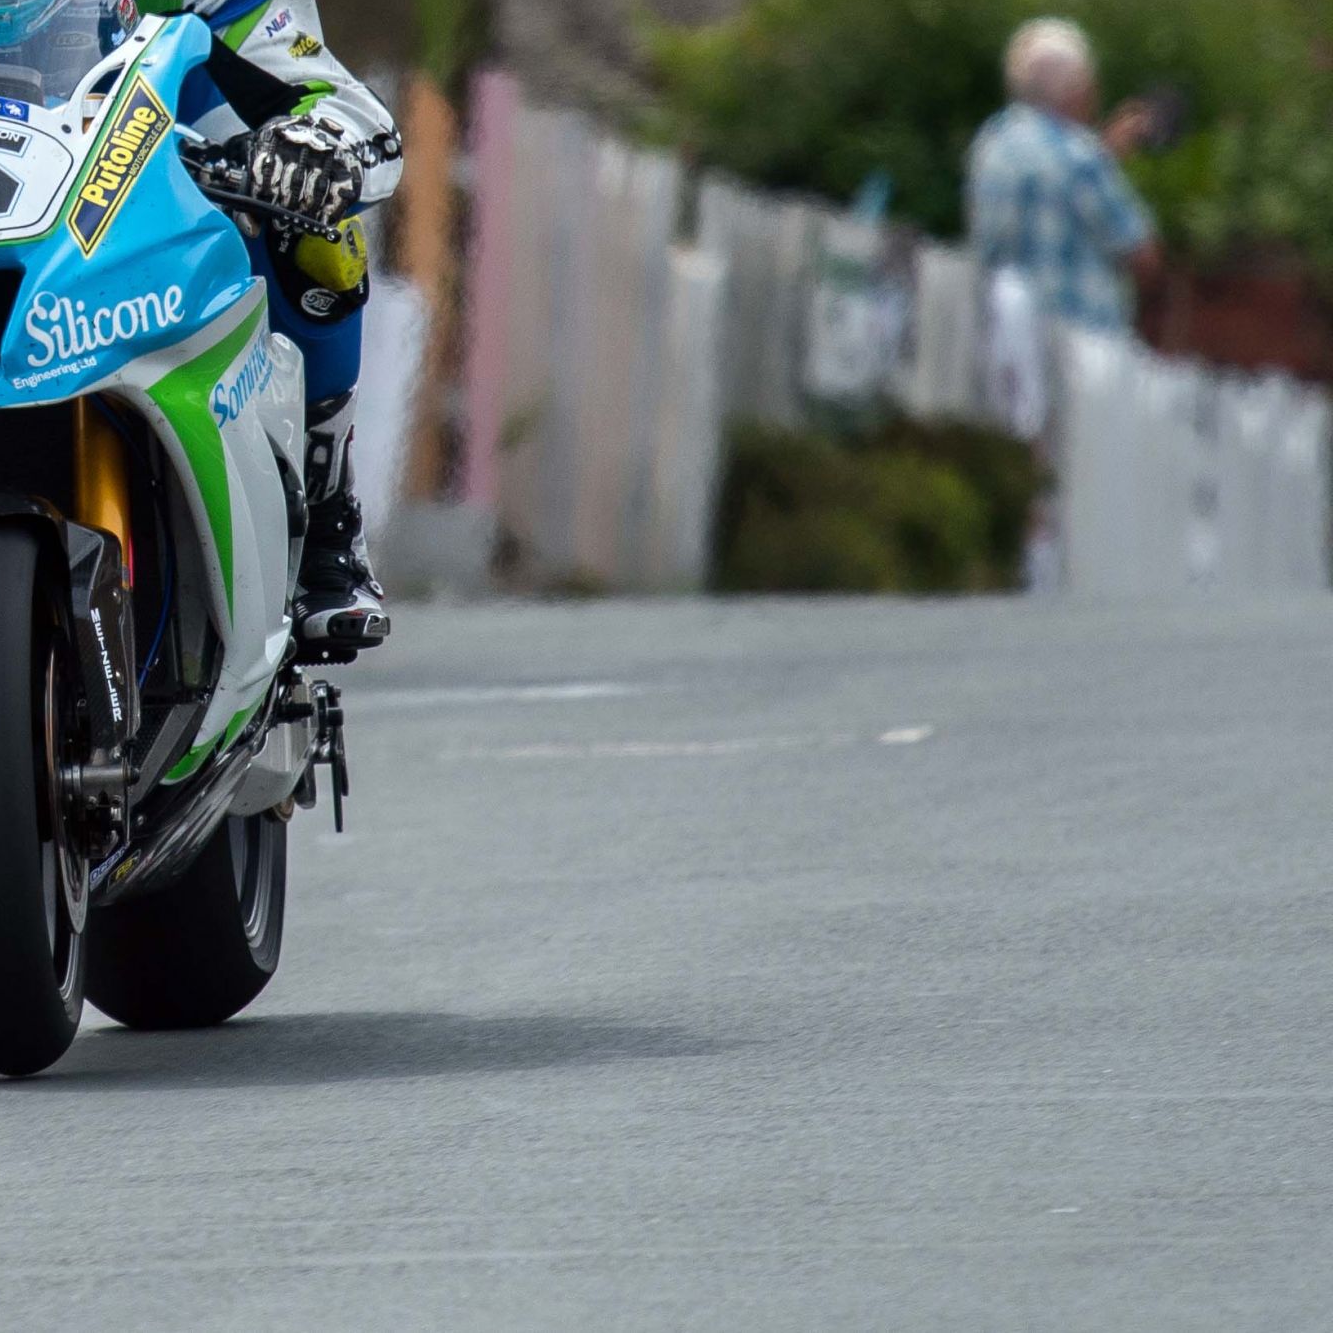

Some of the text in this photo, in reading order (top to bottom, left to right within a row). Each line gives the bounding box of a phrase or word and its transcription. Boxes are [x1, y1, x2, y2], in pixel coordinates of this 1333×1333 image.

[84, 106, 157, 208] Putoline
[25, 284, 185, 367] Silicone
[12, 356, 98, 390] Engineering Ltd
[90, 607, 123, 723] METZELER
